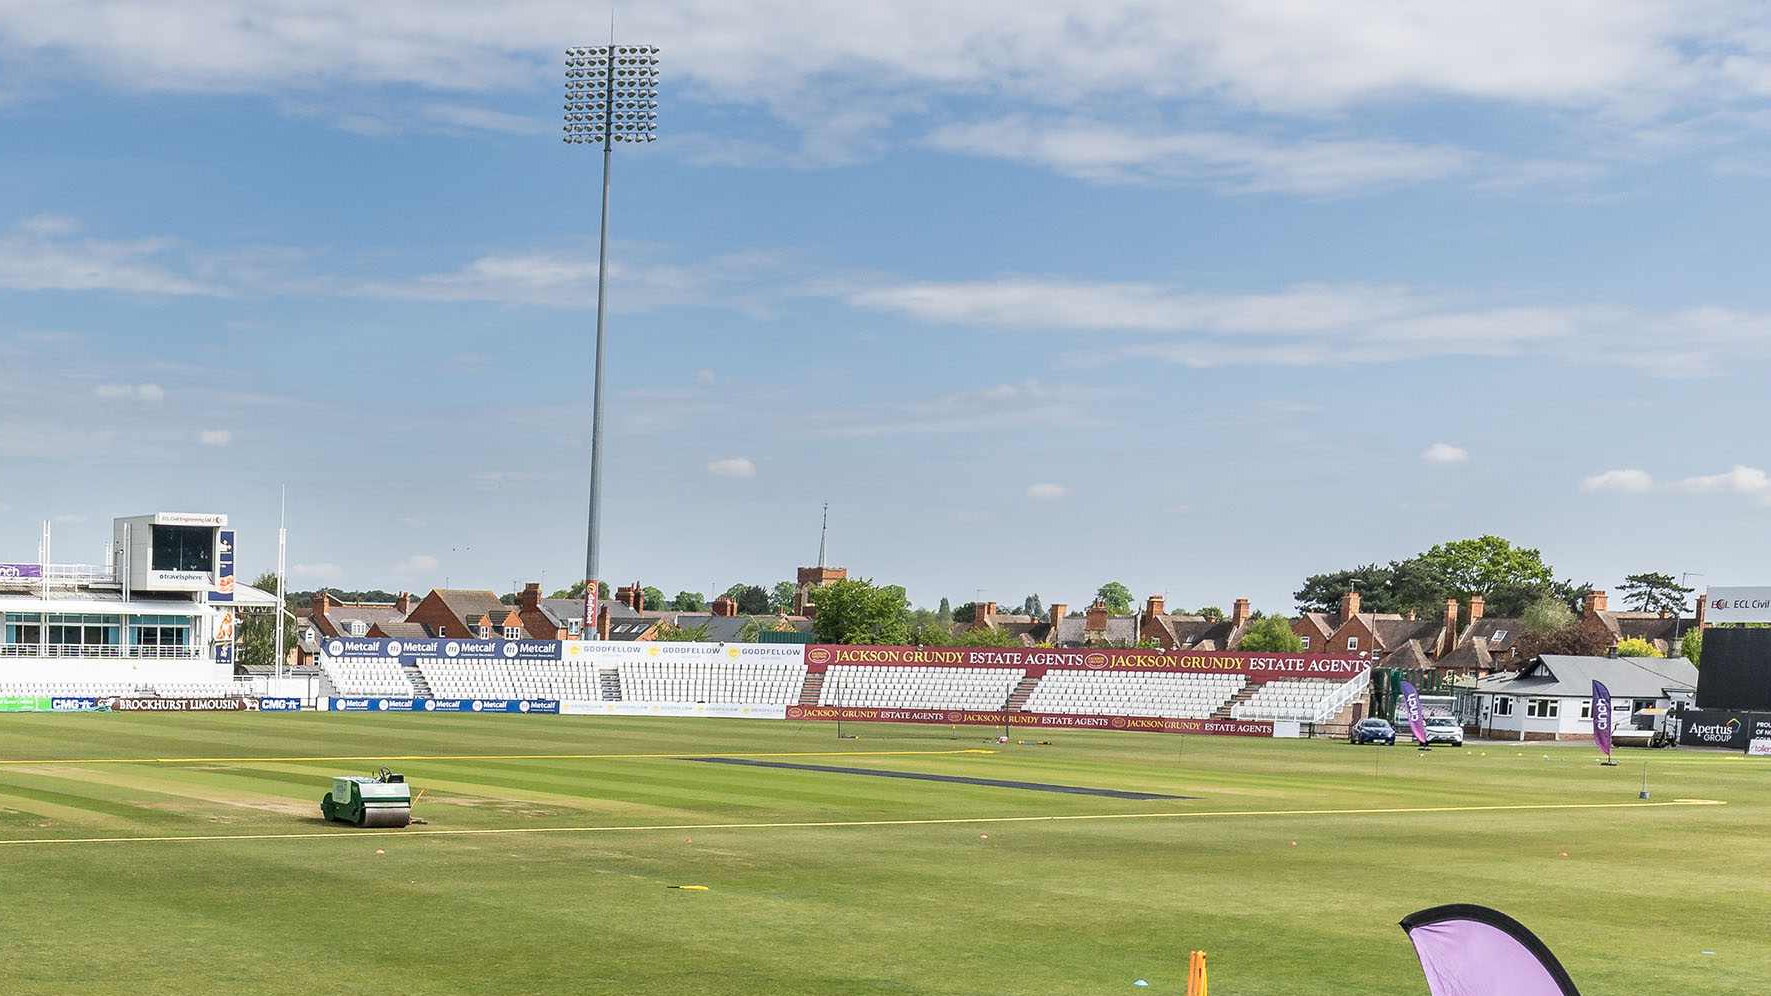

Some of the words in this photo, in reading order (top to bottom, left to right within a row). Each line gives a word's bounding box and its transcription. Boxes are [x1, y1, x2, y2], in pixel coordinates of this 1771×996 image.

[1733, 600, 1750, 609] ECL
[1751, 599, 1770, 609] Civil
[345, 641, 380, 652] Metcalf
[403, 642, 438, 652] Metcalf
[459, 643, 496, 653] Metcalf
[519, 643, 556, 653] Metcalf
[583, 645, 641, 653] GOODFELLOW
[662, 647, 721, 655] GOODFELLOW
[741, 648, 801, 656] GOODFELLOW
[835, 650, 899, 664] JACKSON
[903, 651, 964, 664] GRUNDY
[969, 652, 1021, 665] ESTATE
[1024, 653, 1084, 666] AGENTS
[1109, 654, 1178, 668] JACKSON
[1180, 655, 1244, 670] GRUNDY
[1249, 657, 1304, 671] ESTATE
[1307, 659, 1371, 673] AGENTS
[52, 700, 79, 710] CMG
[119, 699, 187, 710] BROCKHURST
[190, 699, 241, 710] LIMOUSIN
[261, 699, 286, 710] CMG
[346, 699, 369, 708] Metcalf
[388, 700, 413, 708] Metcalf
[436, 700, 460, 708] Metcalf
[483, 700, 508, 709] Metcalf
[530, 701, 556, 709] Metcalf
[1406, 692, 1419, 723] cinch
[803, 709, 840, 718] JACKSON
[842, 710, 878, 718] GRUNDY
[880, 711, 911, 719] ESTATE
[911, 712, 944, 720] AGENTS
[963, 713, 1000, 722] JACKSON
[1002, 715, 1039, 723] GRUNDY
[1041, 716, 1073, 724] ESTATE
[1074, 717, 1108, 726] AGENTS
[1597, 698, 1608, 731] cinch
[1126, 718, 1164, 728] JACKSON
[1164, 720, 1201, 730] GRUNDY
[1204, 722, 1235, 732] ESTATE
[1237, 724, 1272, 733] AGENTS
[1689, 722, 1733, 737] Apertus
[1703, 734, 1732, 742] GROUP
